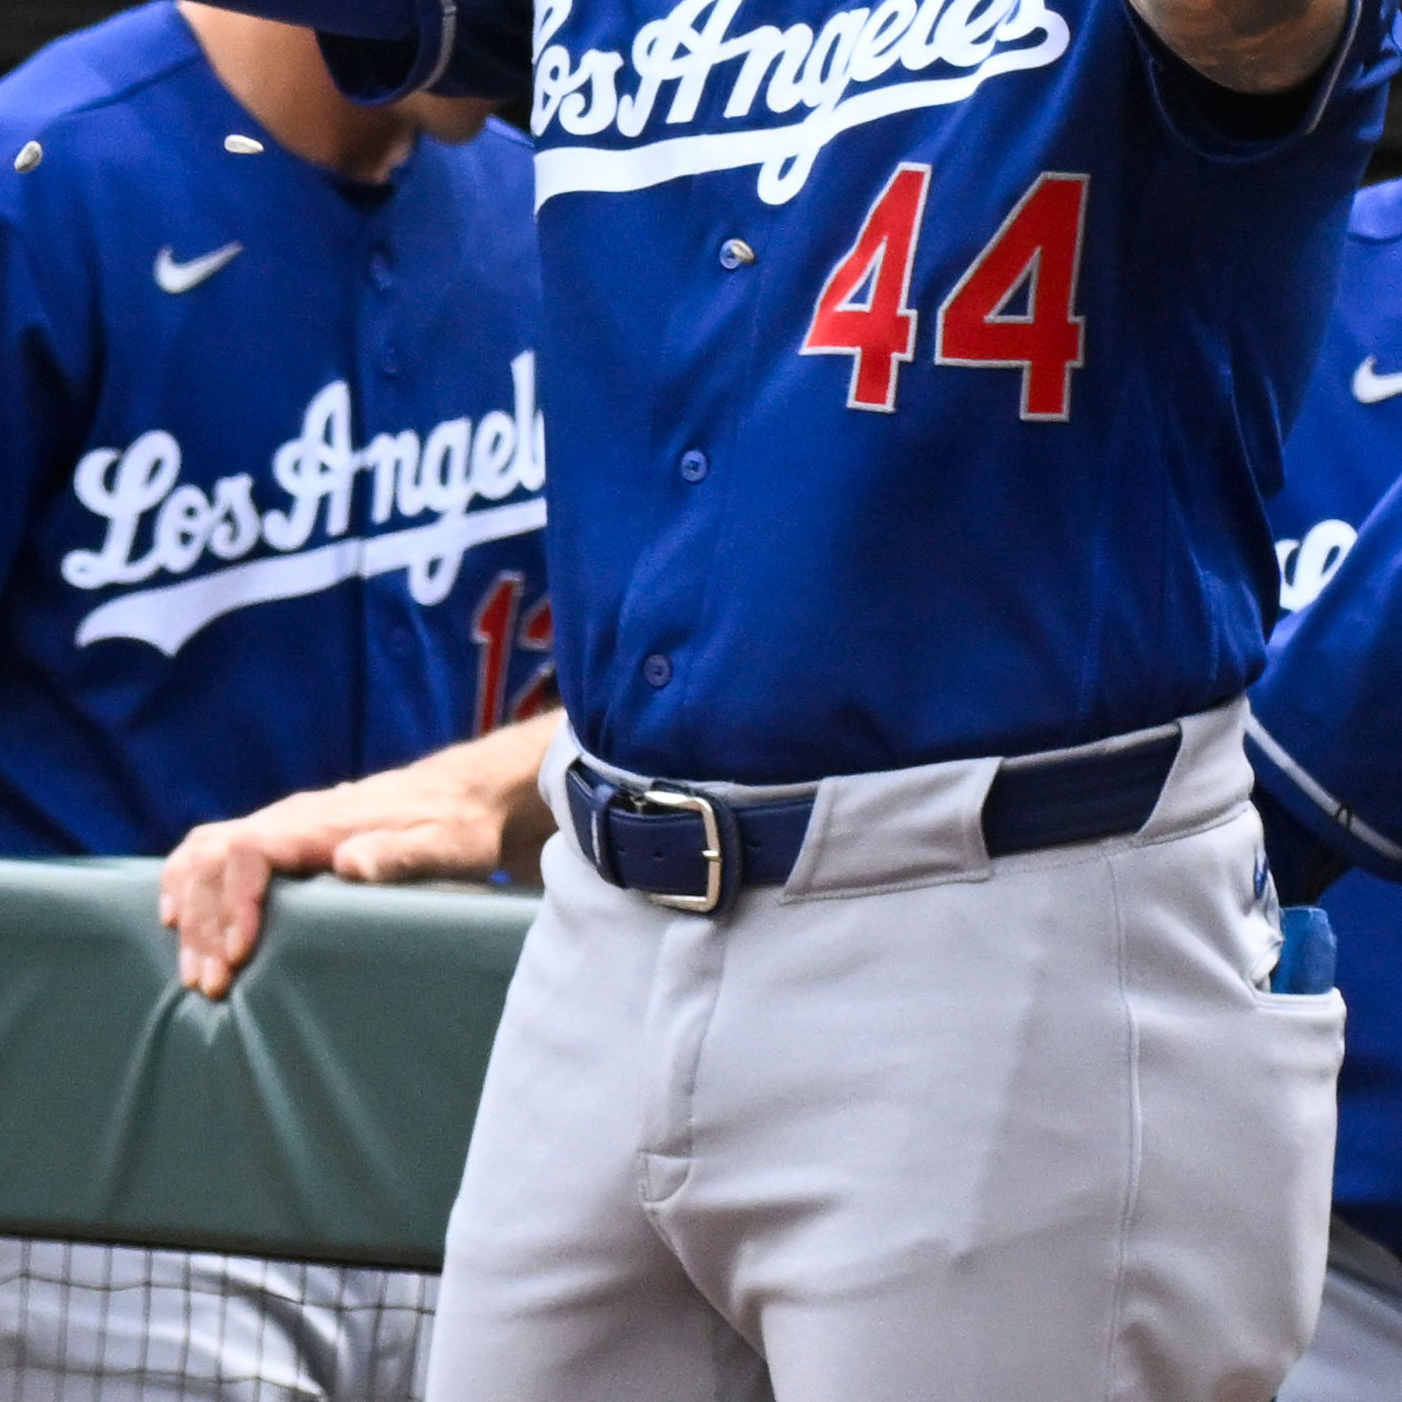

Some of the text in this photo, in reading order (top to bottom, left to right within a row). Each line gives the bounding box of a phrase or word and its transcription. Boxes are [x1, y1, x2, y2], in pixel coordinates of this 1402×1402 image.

[797, 161, 1090, 423] 44
[62, 350, 546, 604] Los Angel
